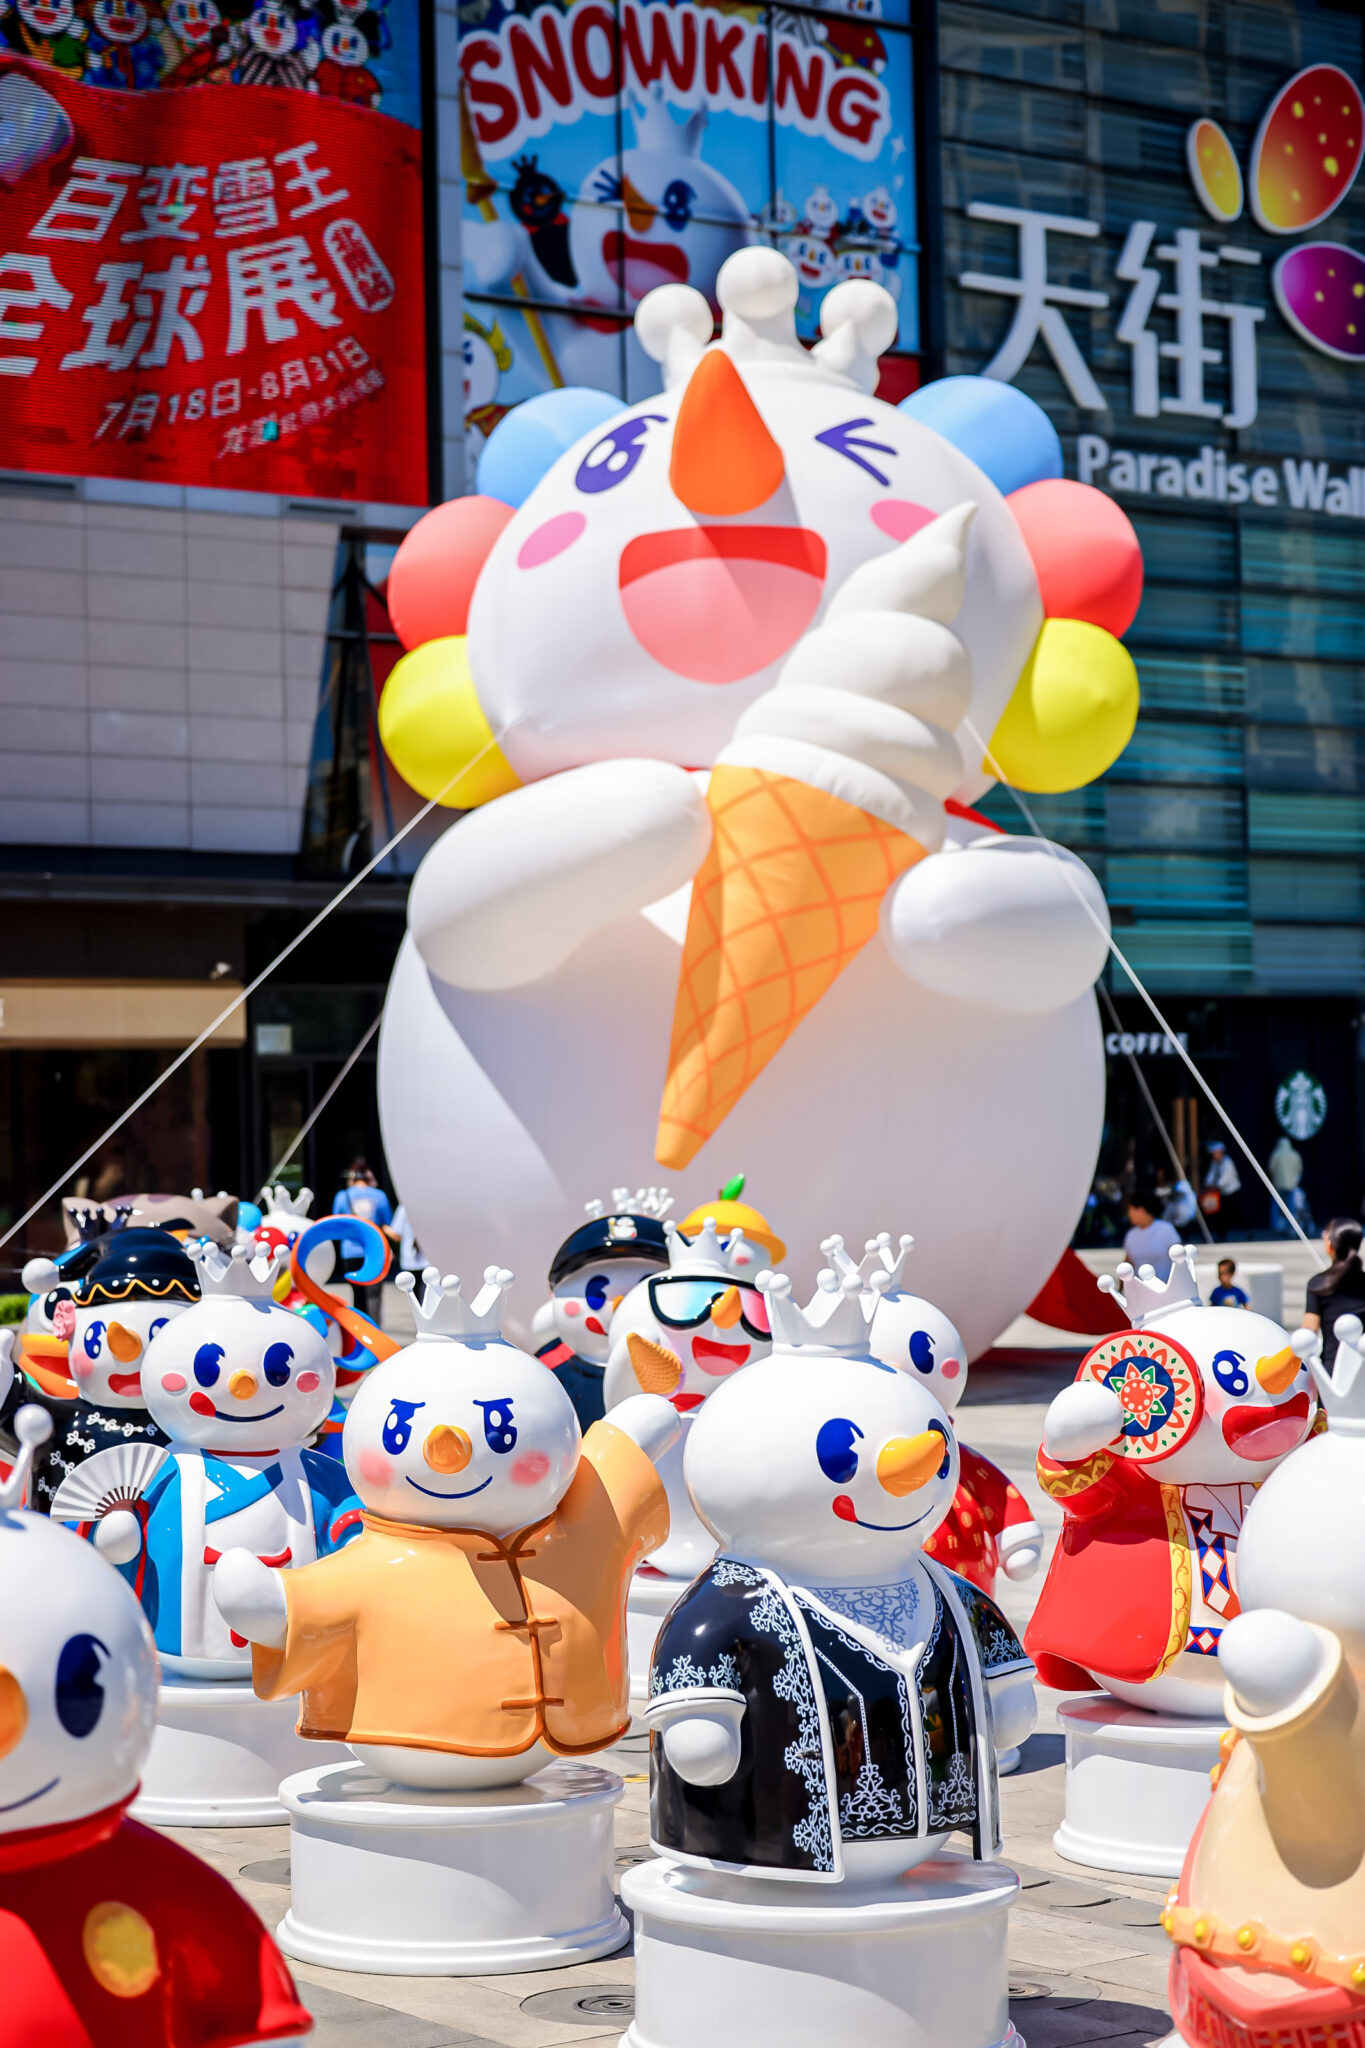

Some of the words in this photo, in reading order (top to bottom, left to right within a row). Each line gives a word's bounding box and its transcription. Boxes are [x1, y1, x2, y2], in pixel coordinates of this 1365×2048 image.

[459, 5, 882, 144] SNOWKING
[28, 140, 349, 243] 百变雪王
[959, 201, 1266, 429] 天街
[1077, 433, 1280, 506] Paradise
[1282, 457, 1365, 518] Wal
